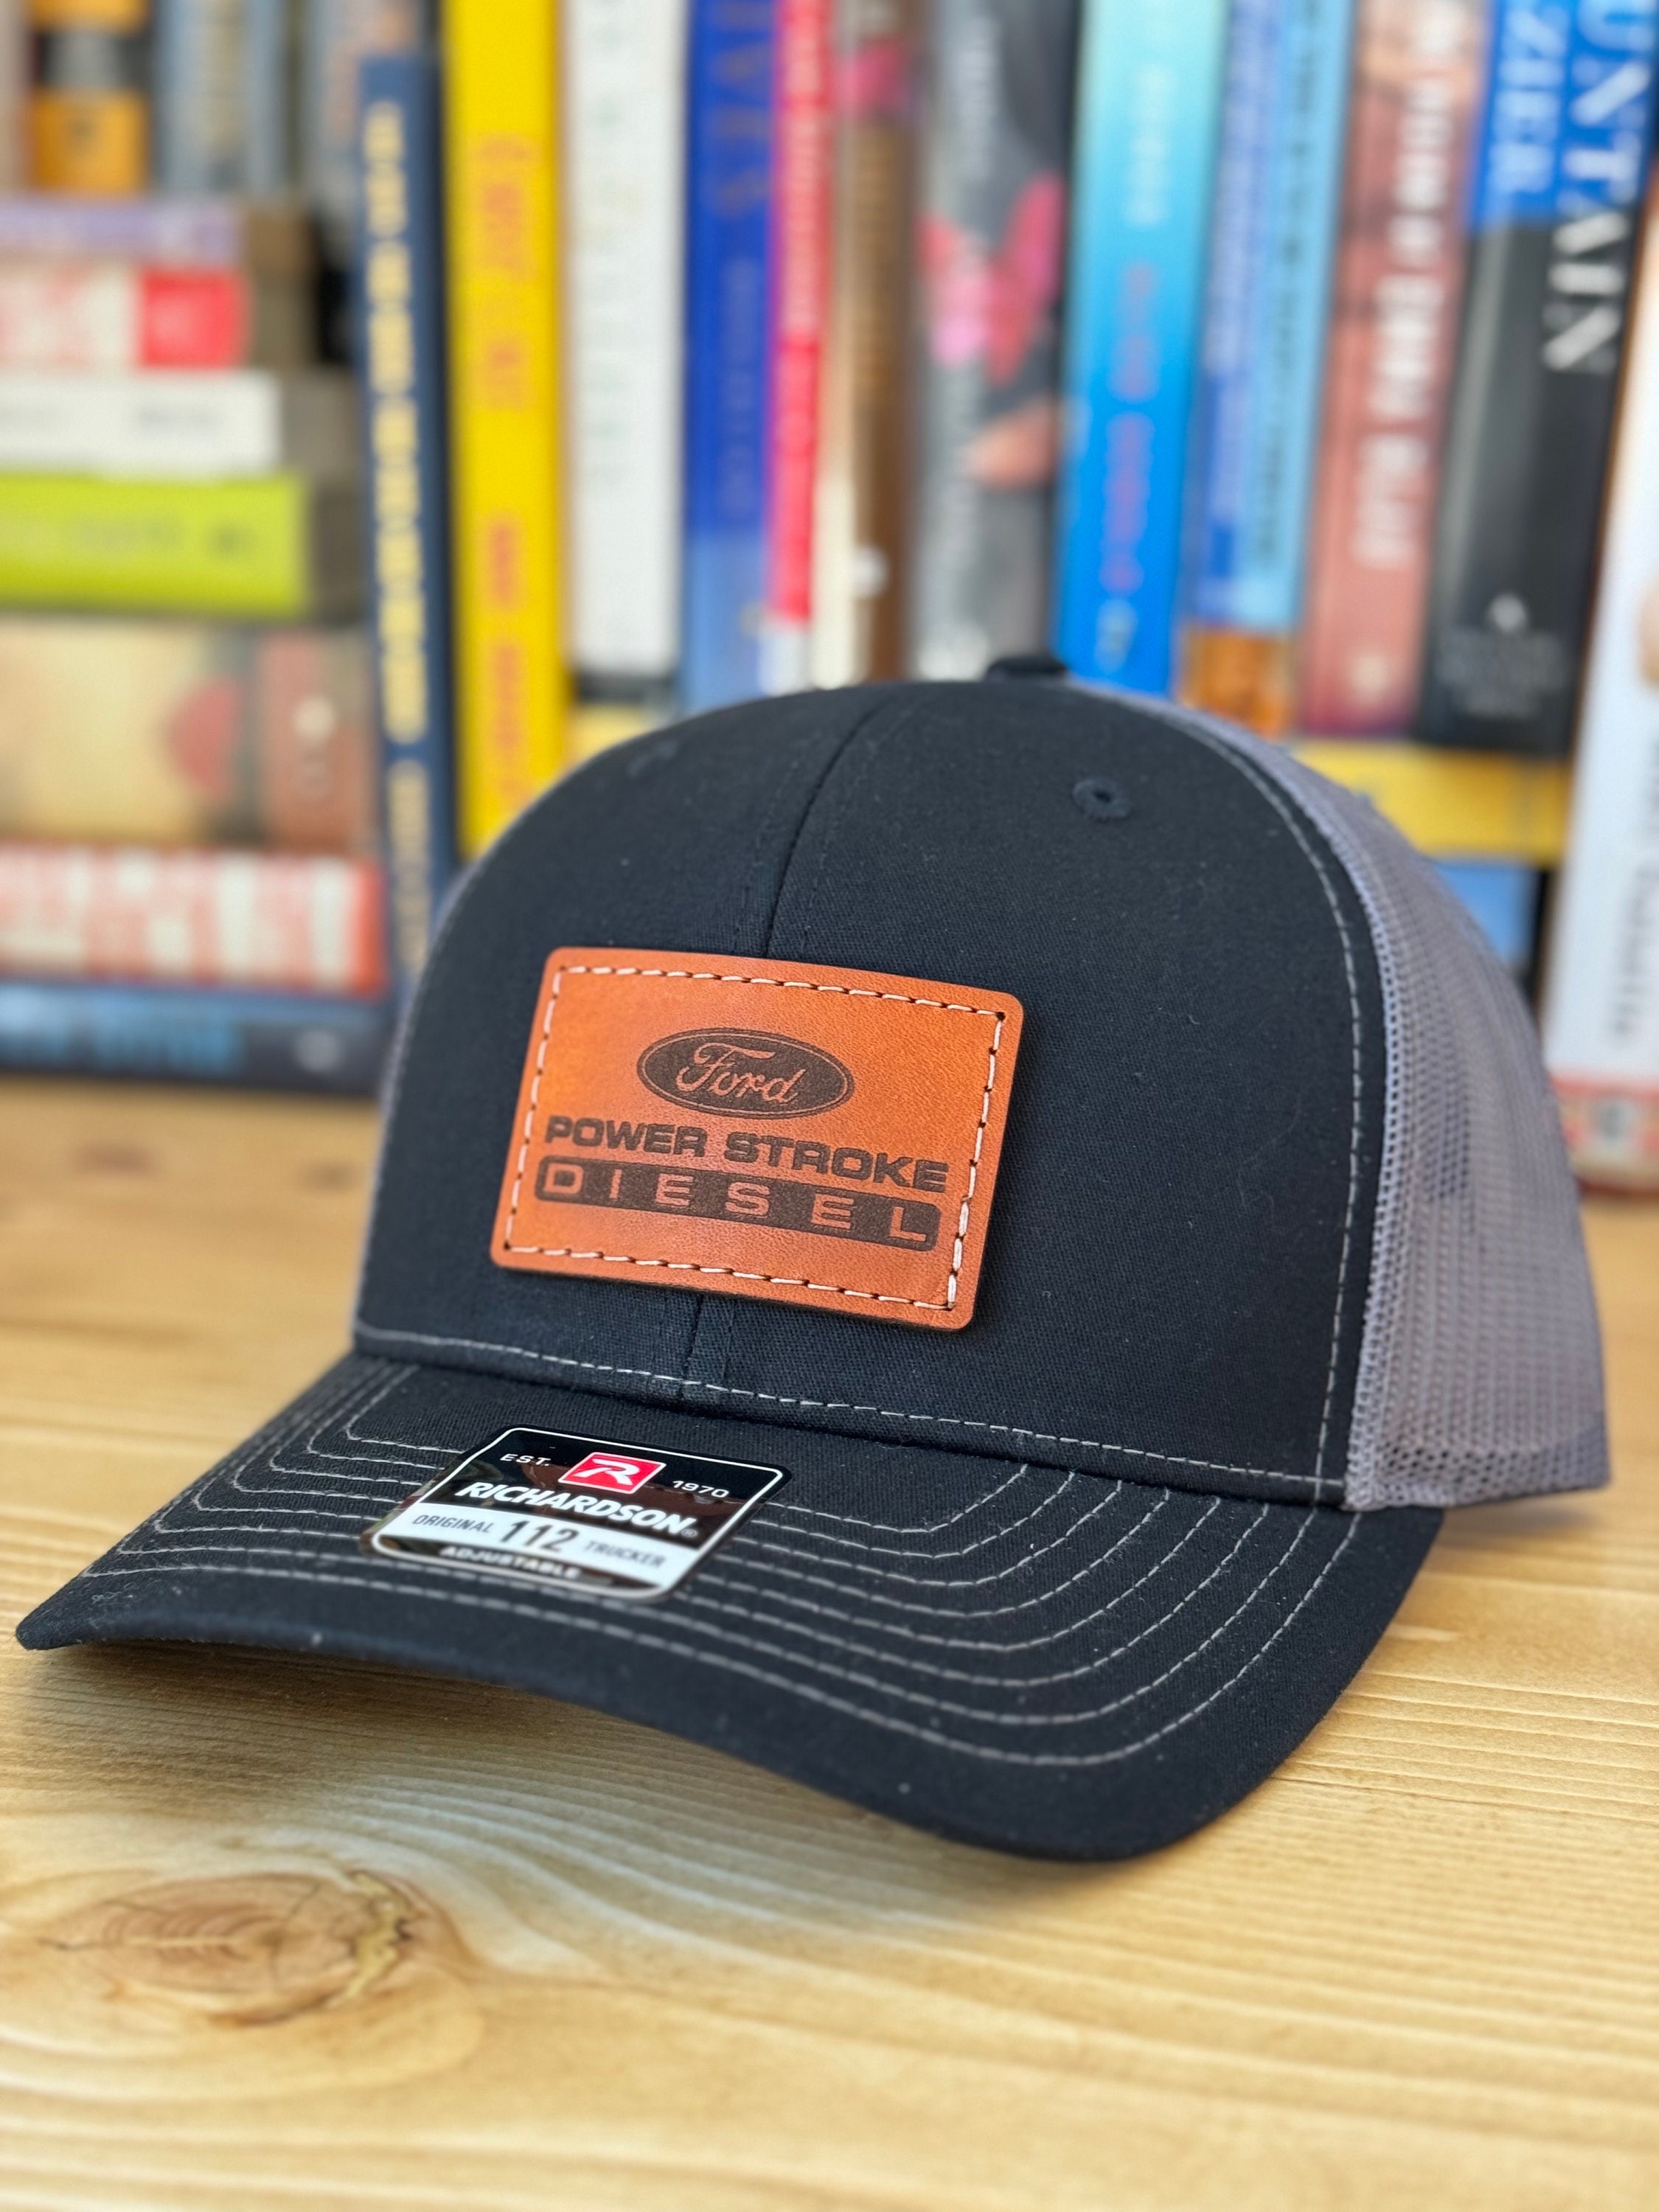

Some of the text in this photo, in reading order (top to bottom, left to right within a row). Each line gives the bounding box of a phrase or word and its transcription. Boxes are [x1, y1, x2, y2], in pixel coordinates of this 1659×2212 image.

[676, 1040, 807, 1106] Ford
[544, 1116, 949, 1194] POWER STROKE
[542, 1164, 928, 1243] DIESEL
[499, 1453, 730, 1498] EST. 1970
[454, 1481, 698, 1536] RICHARDSON
[411, 1514, 667, 1569] ORIGINAL 112 TRUCKER
[439, 1545, 582, 1580] ADJUSTABLE
